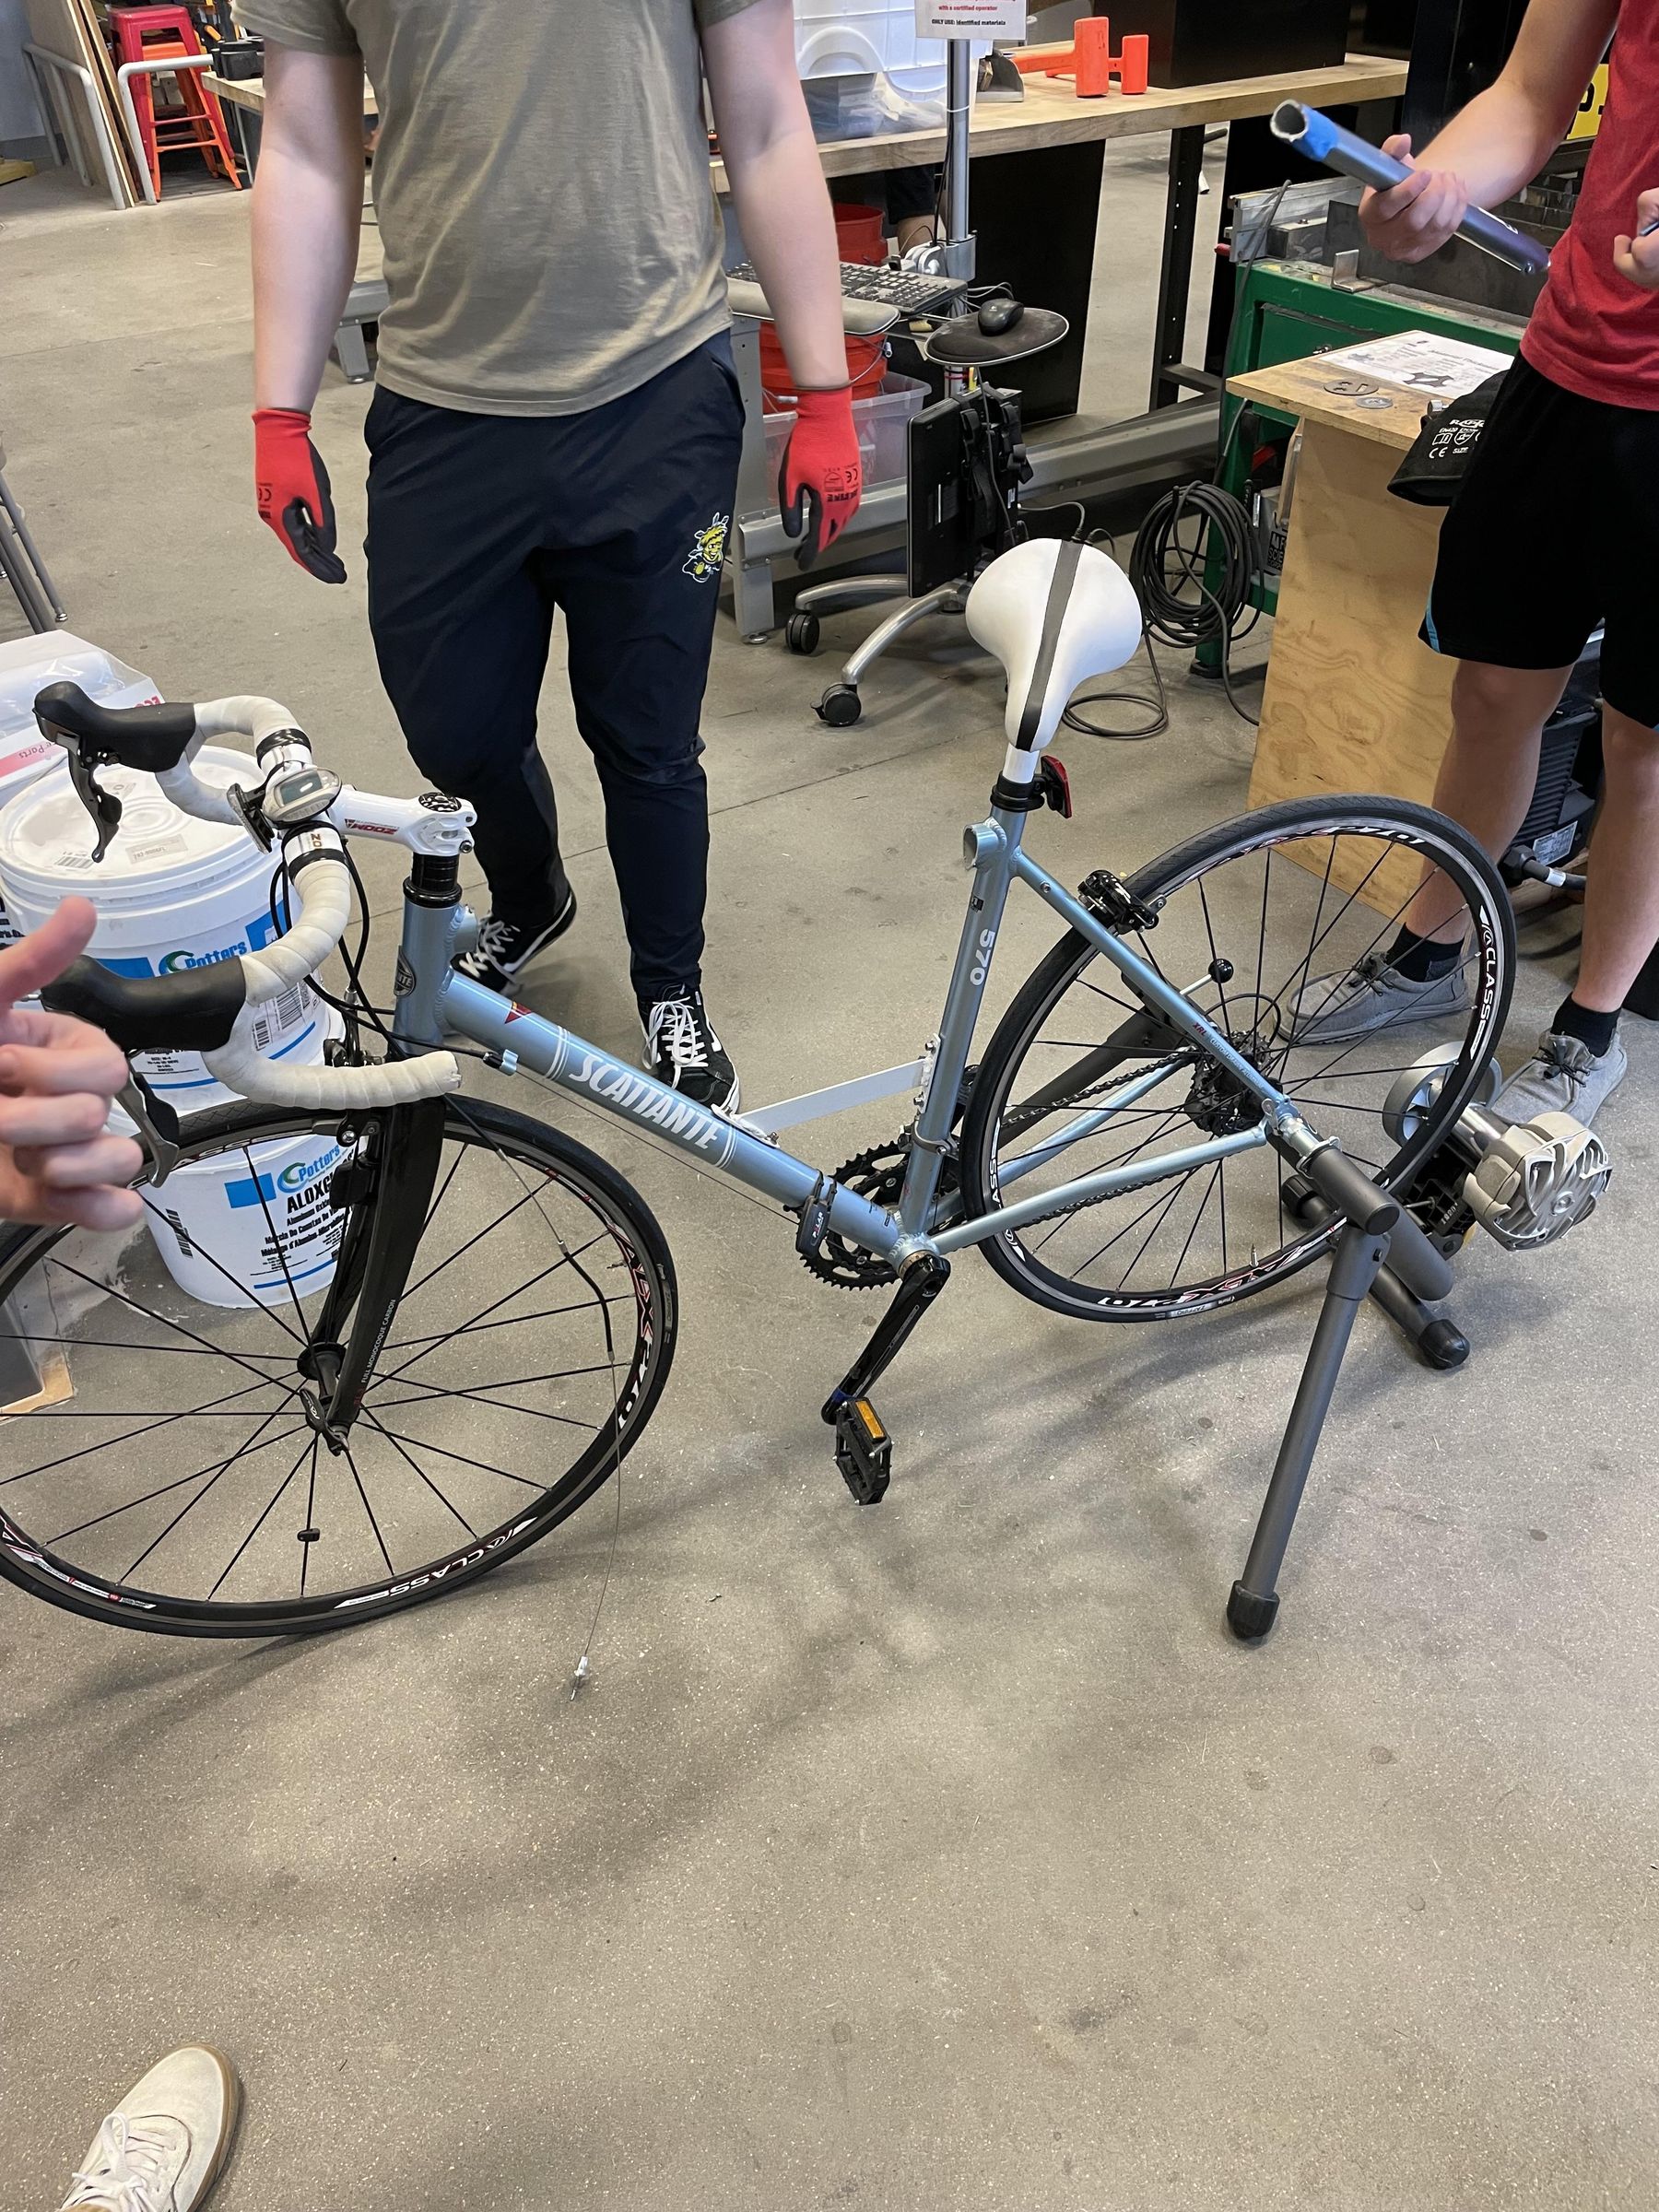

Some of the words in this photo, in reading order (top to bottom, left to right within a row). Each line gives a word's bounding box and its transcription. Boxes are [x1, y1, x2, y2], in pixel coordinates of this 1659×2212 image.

[970, 928, 996, 986] 570
[1480, 947, 1497, 1021] CLASS
[569, 1053, 725, 1150] SCATTANTE
[298, 1145, 341, 1182] Potters
[367, 1326, 387, 1370] MONOCOQUE
[382, 1299, 396, 1326] CARBON
[390, 1548, 485, 1597] CLASS
